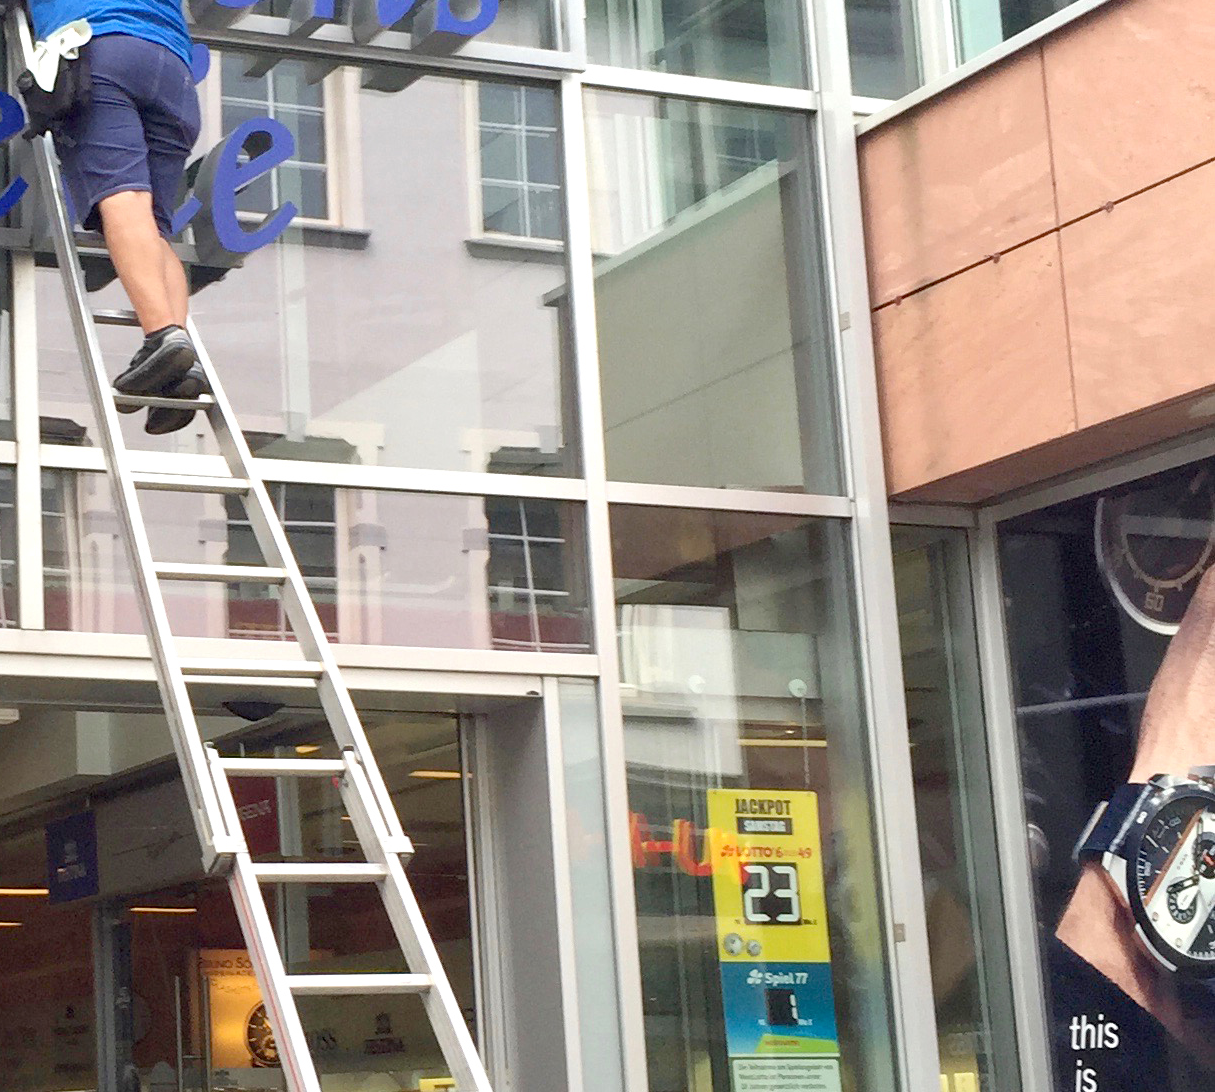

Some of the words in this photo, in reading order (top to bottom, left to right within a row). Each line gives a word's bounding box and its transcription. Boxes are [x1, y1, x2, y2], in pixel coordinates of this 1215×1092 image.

[735, 798, 791, 815] JACKPOT
[742, 865, 802, 923] 23
[764, 971, 795, 987] Spiel
[795, 972, 809, 985] 77
[1069, 1013, 1120, 1050] this
[1075, 1059, 1098, 1092] is
